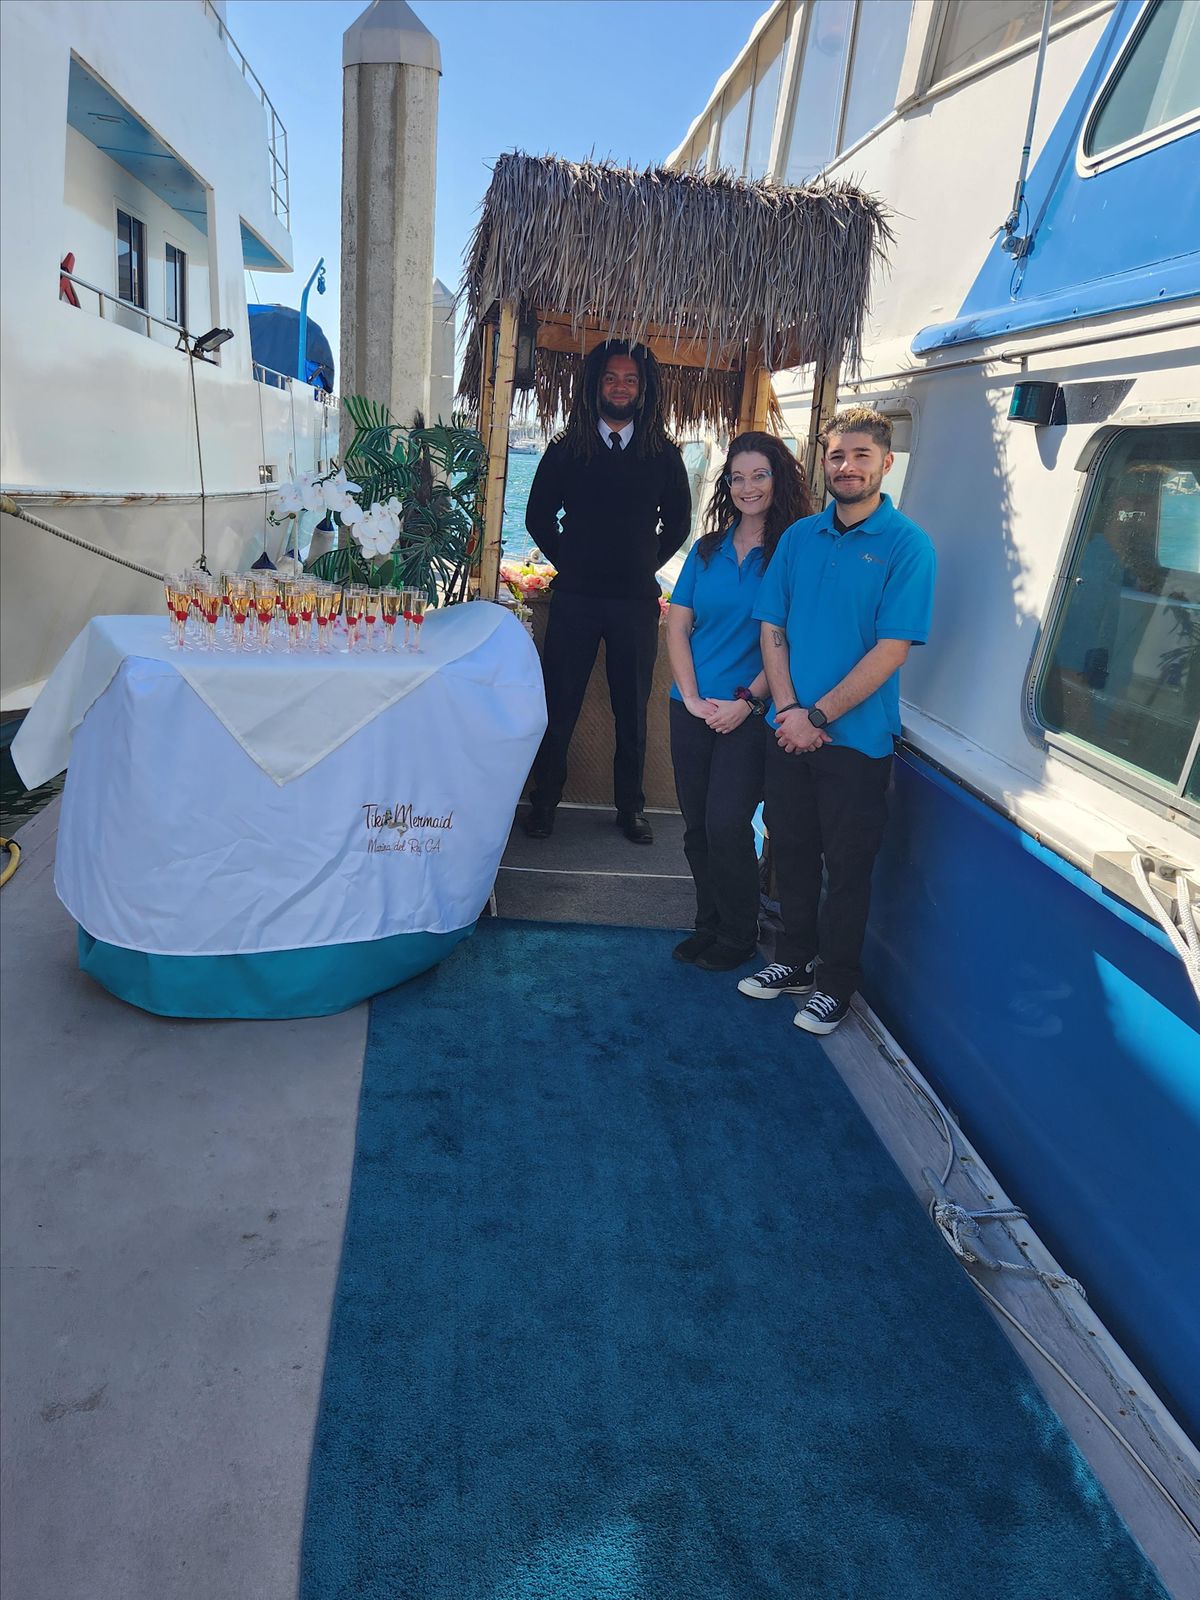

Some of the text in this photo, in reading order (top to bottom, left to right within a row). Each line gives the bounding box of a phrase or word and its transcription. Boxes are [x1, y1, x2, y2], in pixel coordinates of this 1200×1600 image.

[362, 803, 454, 829] Tiki Mermaid
[393, 839, 407, 852] del
[425, 838, 441, 853] CA
